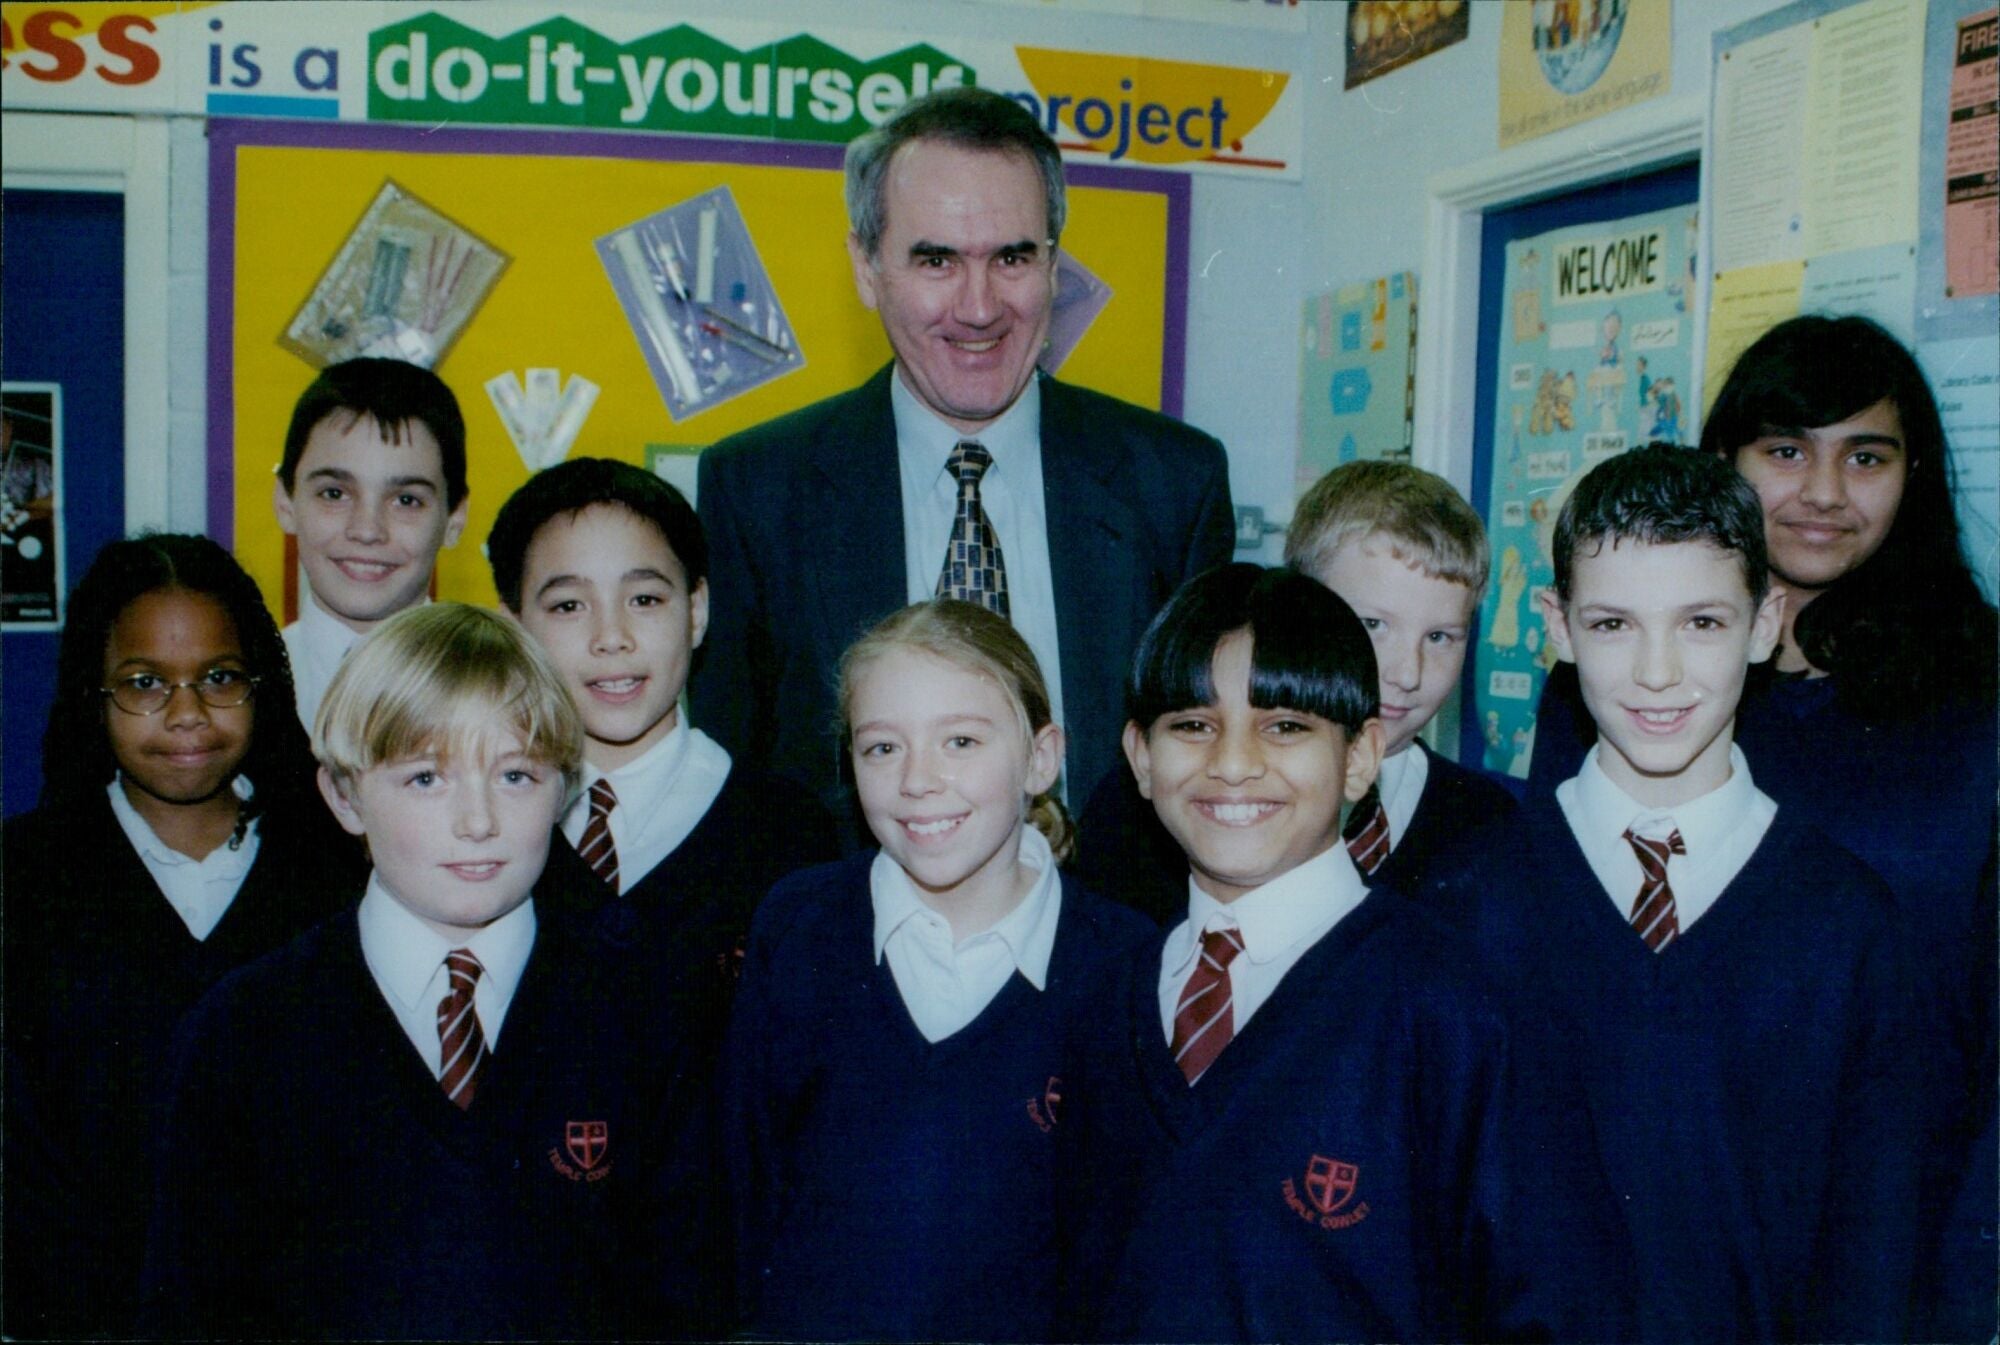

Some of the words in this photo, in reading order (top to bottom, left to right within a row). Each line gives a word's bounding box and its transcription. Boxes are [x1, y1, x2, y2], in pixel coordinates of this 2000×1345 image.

[0, 10, 160, 86] ss
[208, 19, 262, 88] is
[293, 47, 338, 91] a
[1961, 23, 1998, 55] FIRE
[1557, 234, 1658, 296] WELCOME
